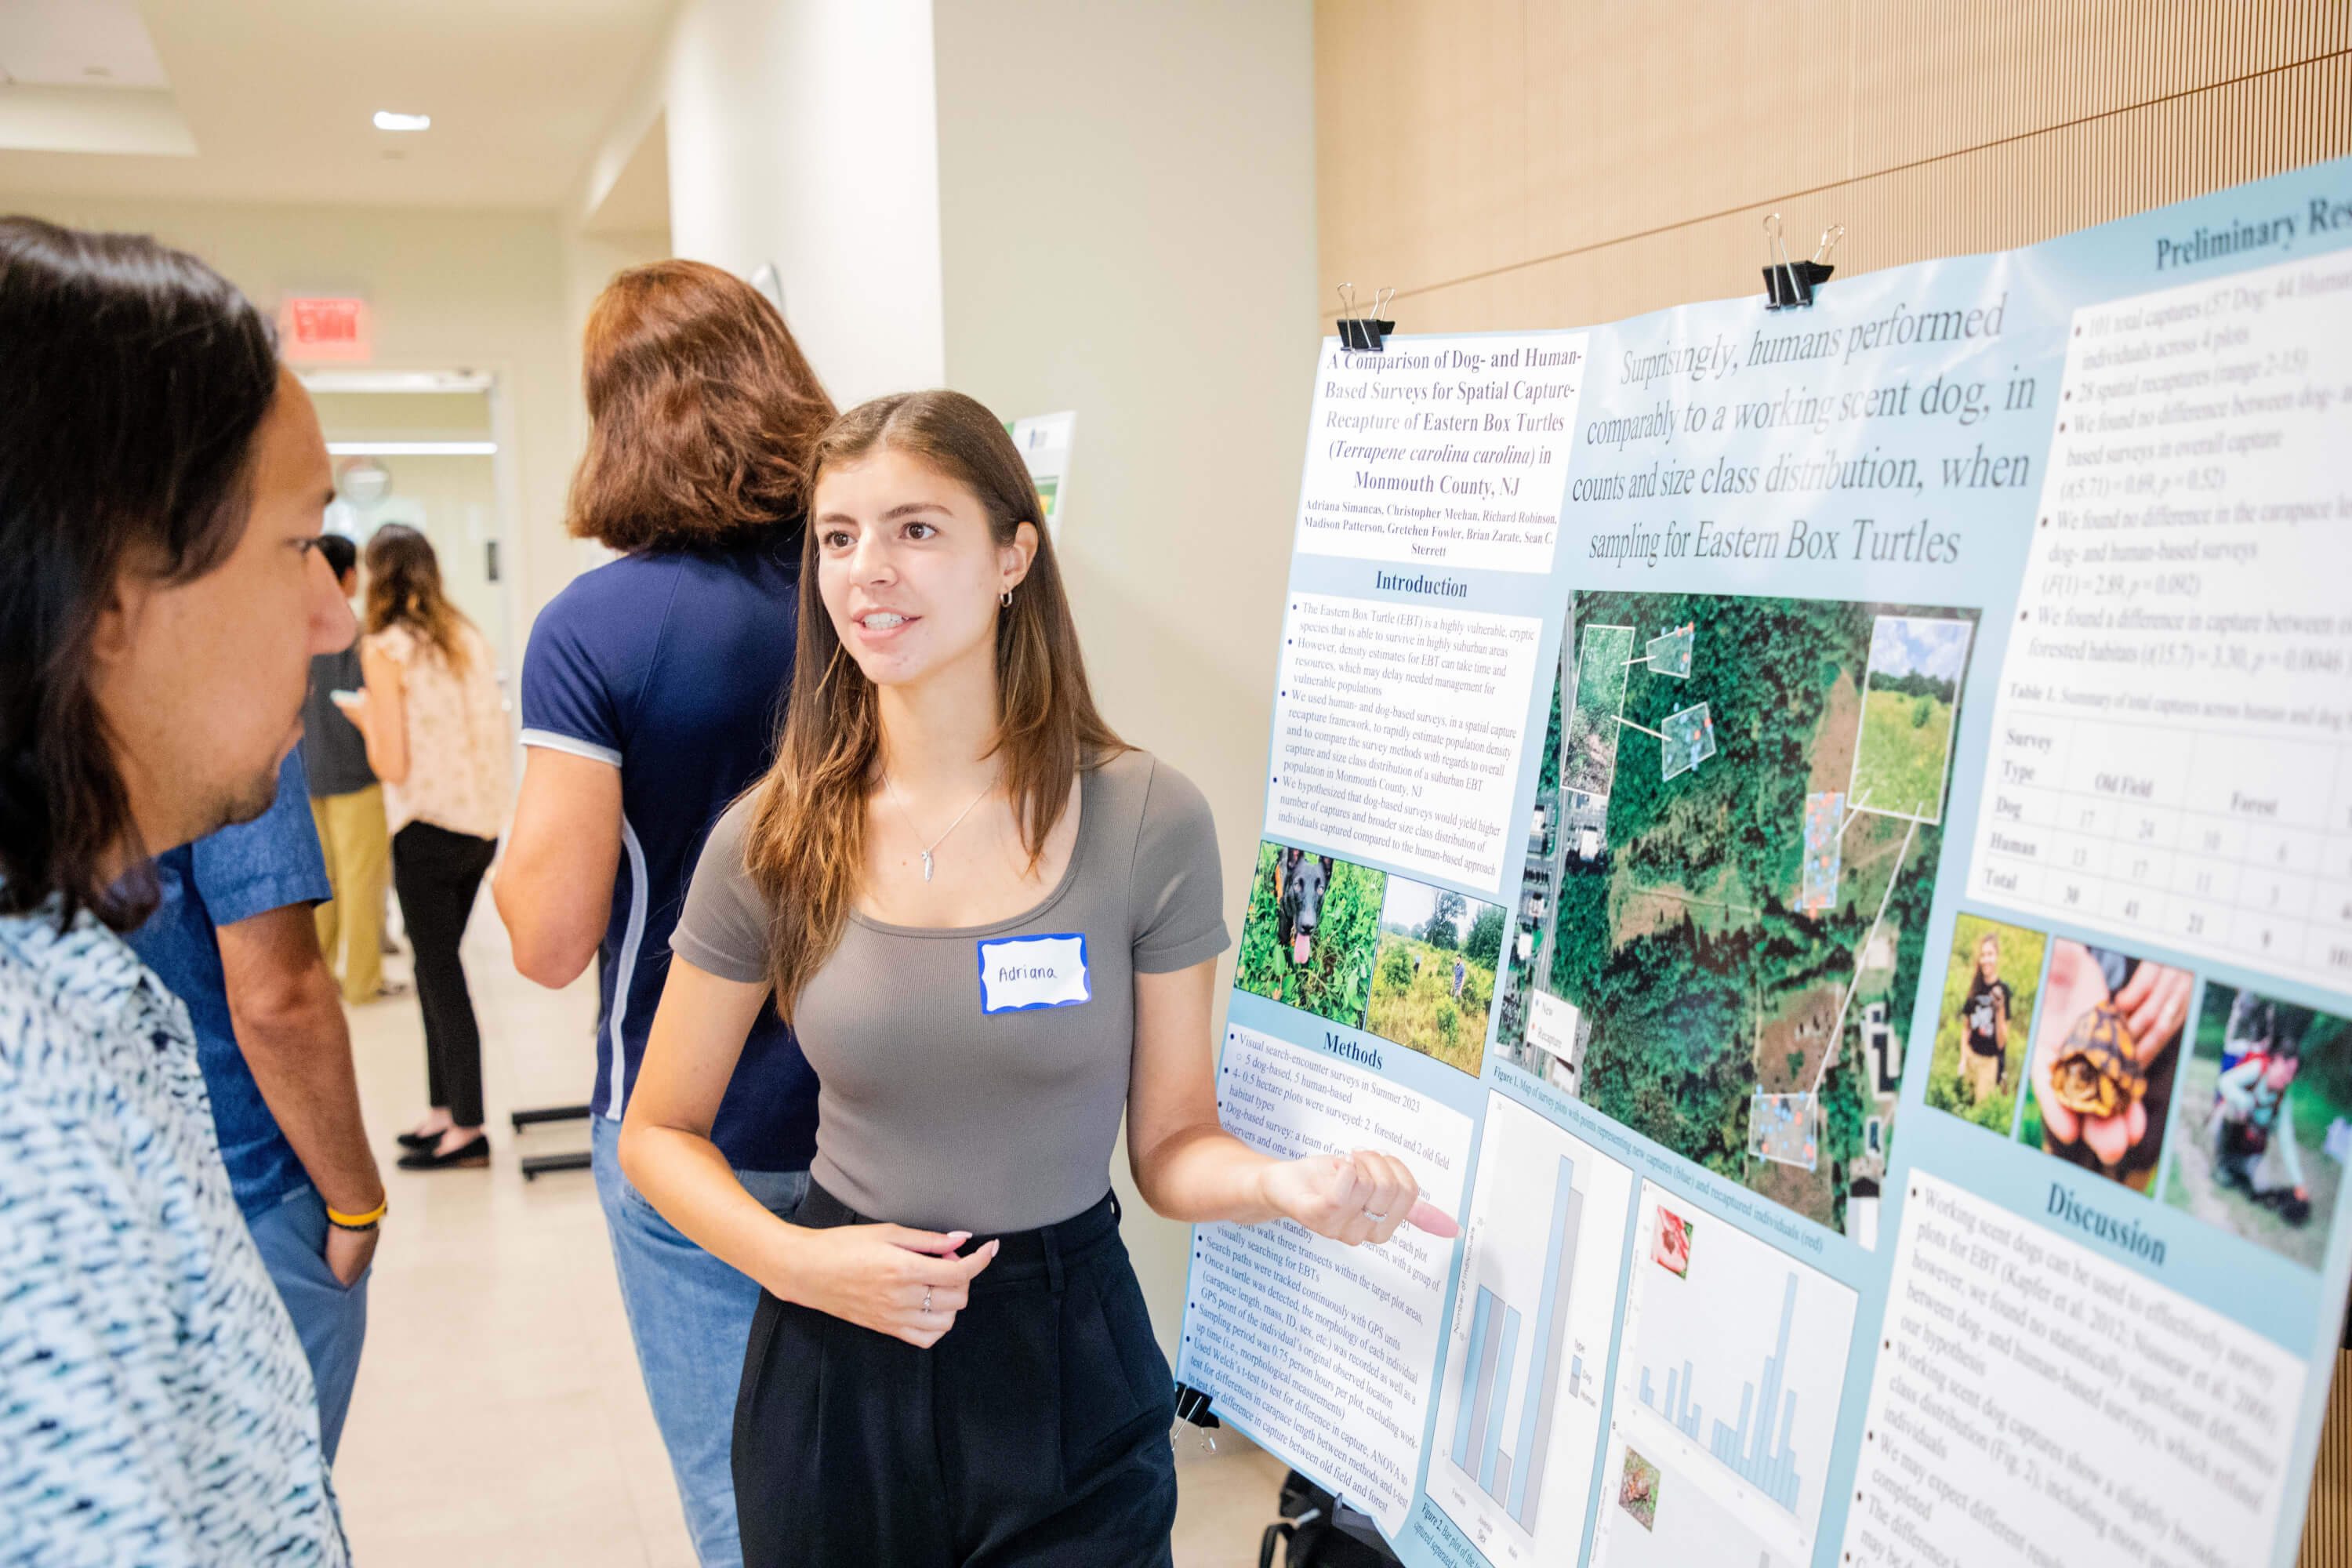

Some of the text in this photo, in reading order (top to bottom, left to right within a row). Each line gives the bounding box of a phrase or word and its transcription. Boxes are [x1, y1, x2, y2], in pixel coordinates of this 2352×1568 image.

[2157, 218, 2297, 270] Preliminary
[1621, 292, 2008, 390] Surprisingly, humans performed
[1327, 349, 1582, 375] A Comparison of Dog- and Human-
[1325, 381, 1575, 405] Based Surveys for Spatial Capture-
[1326, 411, 1564, 434] Recapture of Eastern Box Turtles
[1587, 365, 2036, 452] comparably to a working scent dog, in
[1329, 440, 1552, 467] (Terrapene carolina carolina) in
[1354, 470, 1520, 500] Monmouth County, NJ
[1572, 444, 2031, 503] counts and size class distribution, when
[1308, 499, 1558, 524] Adriana Simancas, Christopher Meehan, Richard Robinson,
[1305, 516, 1340, 529] Madison
[1387, 523, 1428, 536] Gretchen
[1466, 528, 1490, 540] Brian
[1524, 532, 1543, 544] Sean
[1588, 520, 1961, 568] sampling for Eastern Box Turtles
[1411, 543, 1446, 557] Sterrett
[1375, 570, 1468, 597] Introduction
[1303, 602, 1319, 615] The
[1320, 604, 1350, 619] Eastern
[1352, 608, 1368, 621] Box
[1371, 609, 1395, 624] Turtle
[1396, 614, 1423, 628] (EBT)
[1425, 616, 1432, 629] is
[1439, 618, 1464, 635] highly
[1467, 622, 1508, 638] vulnerable,
[1509, 628, 1535, 643] cryptic
[1298, 637, 1507, 677] However, density estimates for EBT can take time and
[1294, 673, 1382, 696] vulnerable populations
[2005, 726, 2053, 754] Survey
[1283, 760, 1423, 797] population in Monmouth County, NJ
[2002, 760, 2035, 782] Type
[1283, 775, 1501, 837] We hypothesized that dog-based surveys would yield higher
[1995, 796, 2023, 819] Dog
[1990, 832, 2037, 858] Human
[1984, 869, 2017, 891] Total
[999, 964, 1058, 982] Adriana
[1323, 1032, 1383, 1070] Methods
[1240, 1033, 1420, 1112] Visual search-encounter surveys in Summer 2023
[1245, 1054, 1352, 1104] 5 dog-based, 5 human-based
[1494, 1065, 1519, 1088] Figure 1.
[1229, 1084, 1275, 1112] habitat types
[2047, 1181, 2166, 1267] Discussion
[1217, 1225, 1319, 1282] visually searching for EBTs
[1206, 1236, 1401, 1349] Search paths were tracked continuously with GPS units
[1188, 1371, 1388, 1513] to test for difference in capture between old field and forest
[1421, 1502, 1444, 1531] Figure 2.
